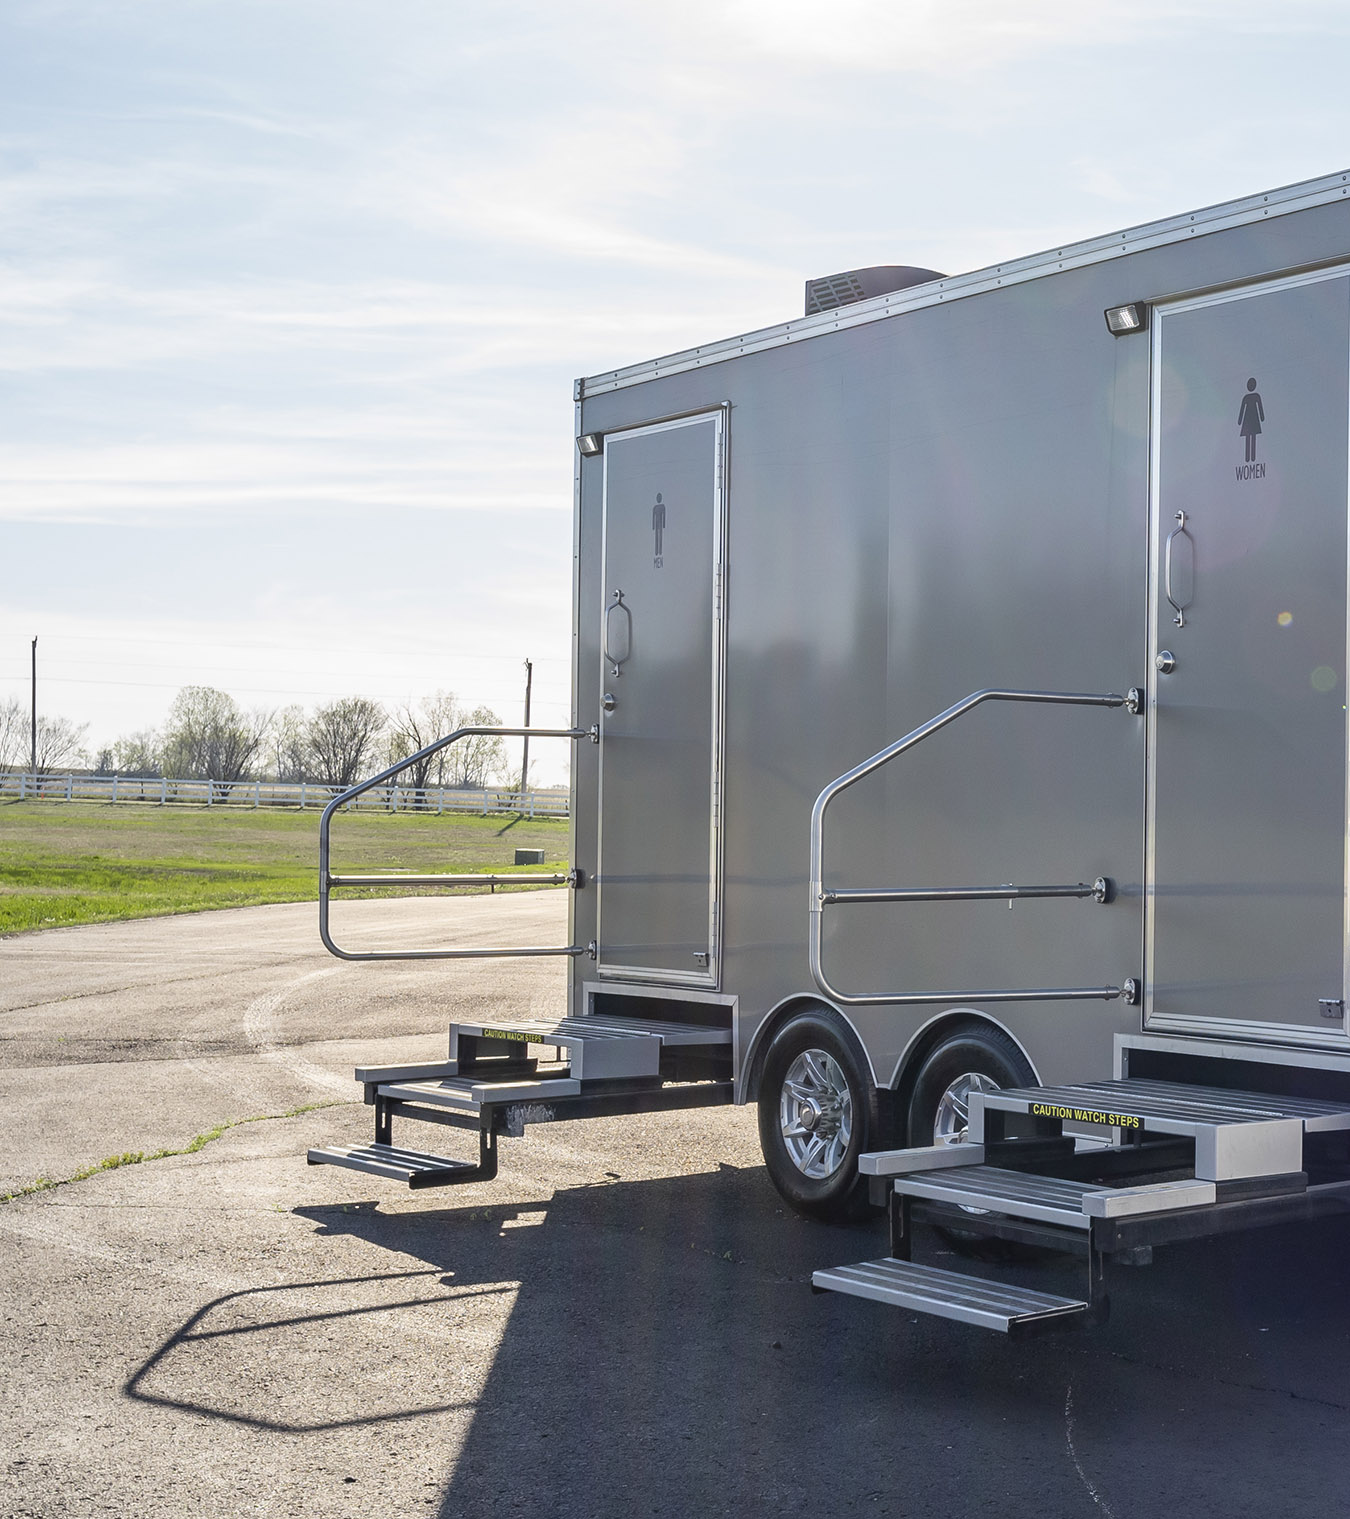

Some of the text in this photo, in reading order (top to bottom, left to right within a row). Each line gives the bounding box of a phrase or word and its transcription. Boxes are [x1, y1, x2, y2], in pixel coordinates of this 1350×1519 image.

[1235, 463, 1266, 481] WOMEN
[653, 556, 664, 569] MEN
[484, 1029, 542, 1043] CAUTION WATCH STEPS
[1033, 1103, 1139, 1128] CAUTION WATCH STEPS
